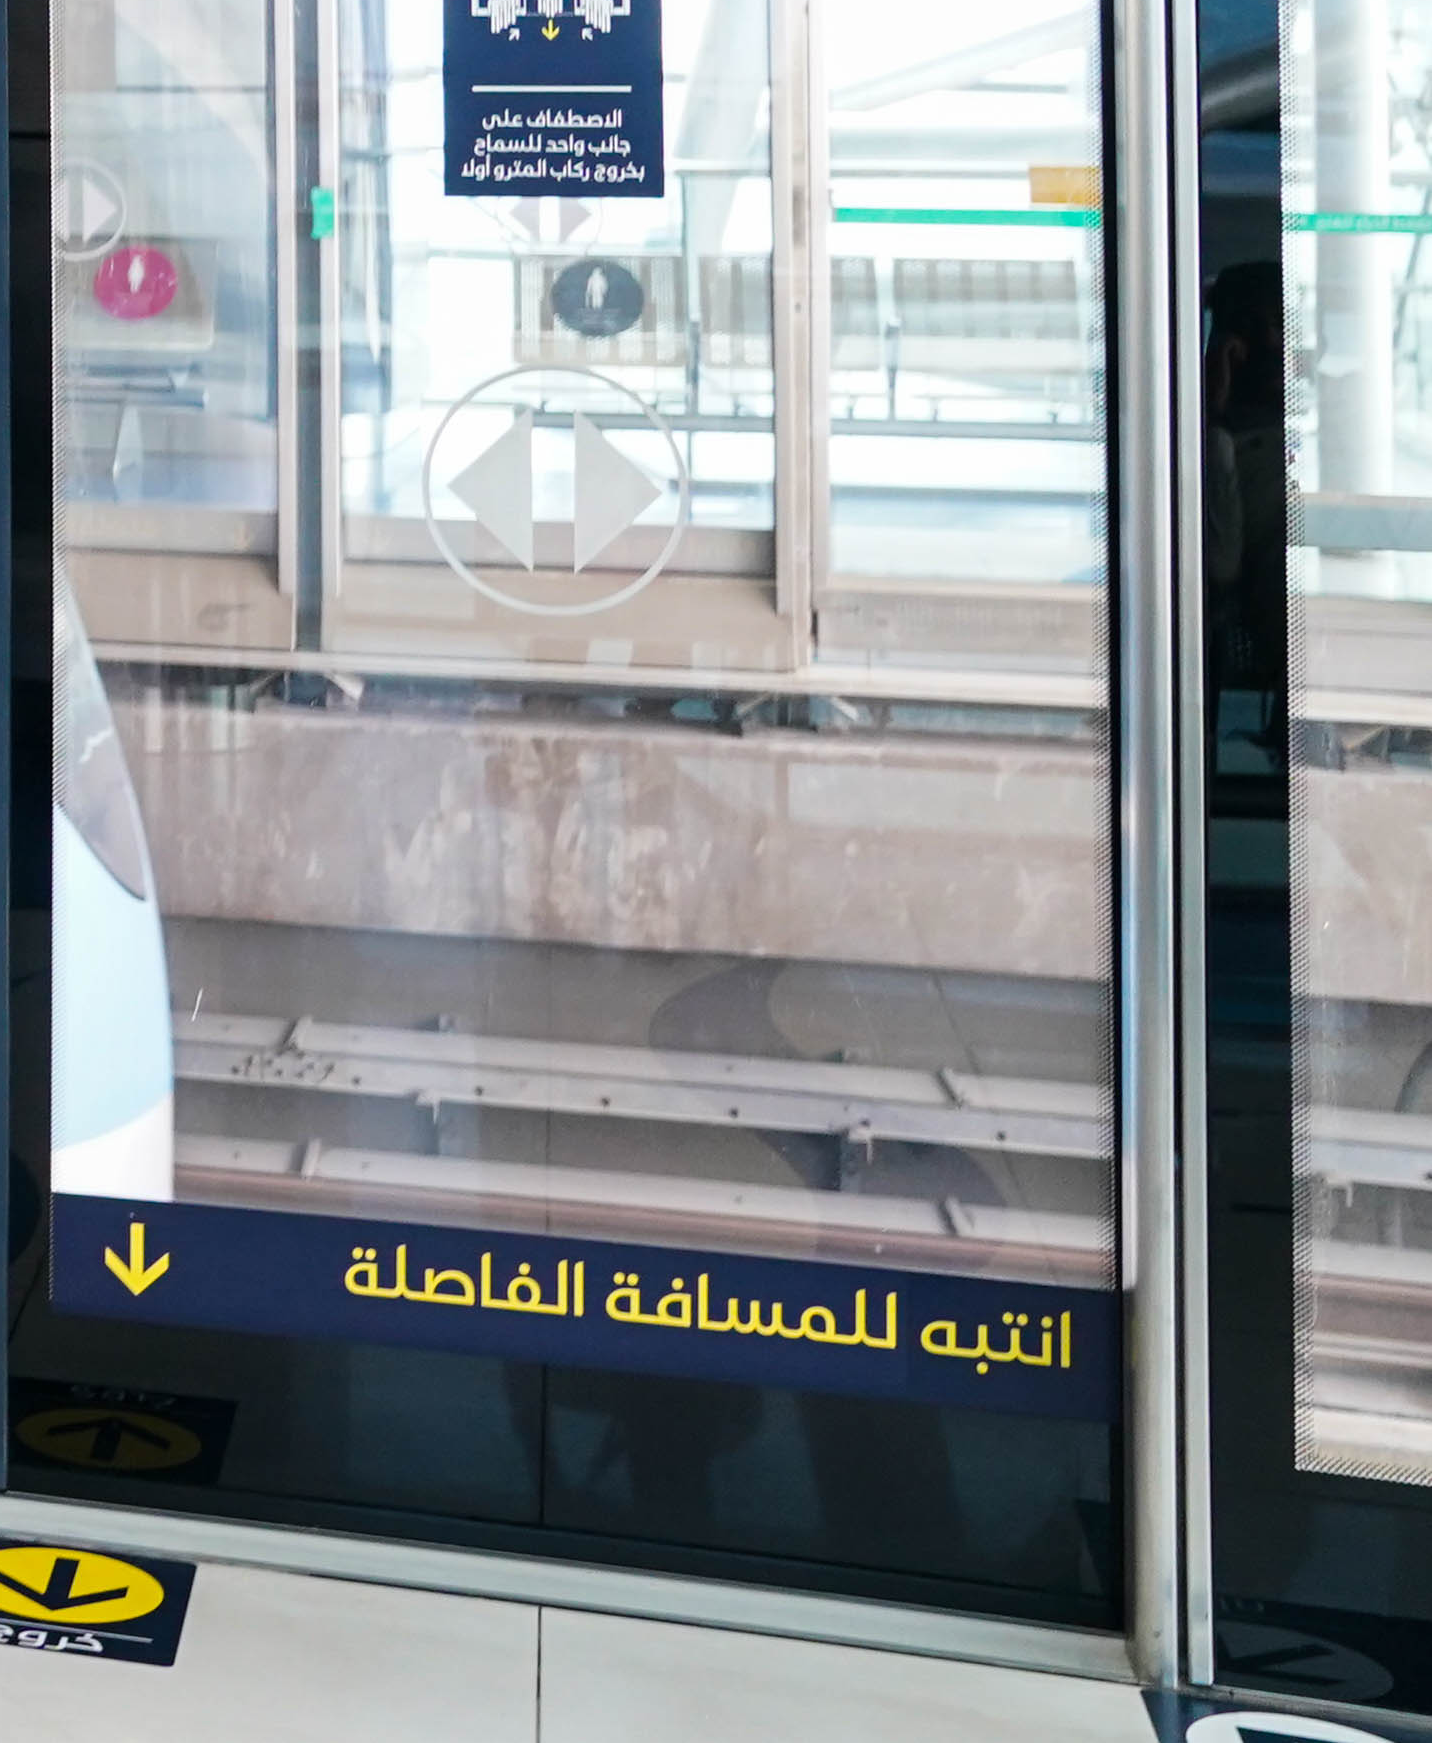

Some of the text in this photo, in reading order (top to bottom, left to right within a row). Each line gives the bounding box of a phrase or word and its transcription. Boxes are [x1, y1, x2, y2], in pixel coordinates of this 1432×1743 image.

[481, 108, 623, 130] الاصطفاف على
[473, 132, 631, 158] جانب واحد للسماح
[493, 158, 547, 182] المترو
[549, 158, 591, 183] ركاب
[593, 159, 646, 184] بخروج
[343, 1243, 1072, 1376] انتبه للمسافة الفاصلة
